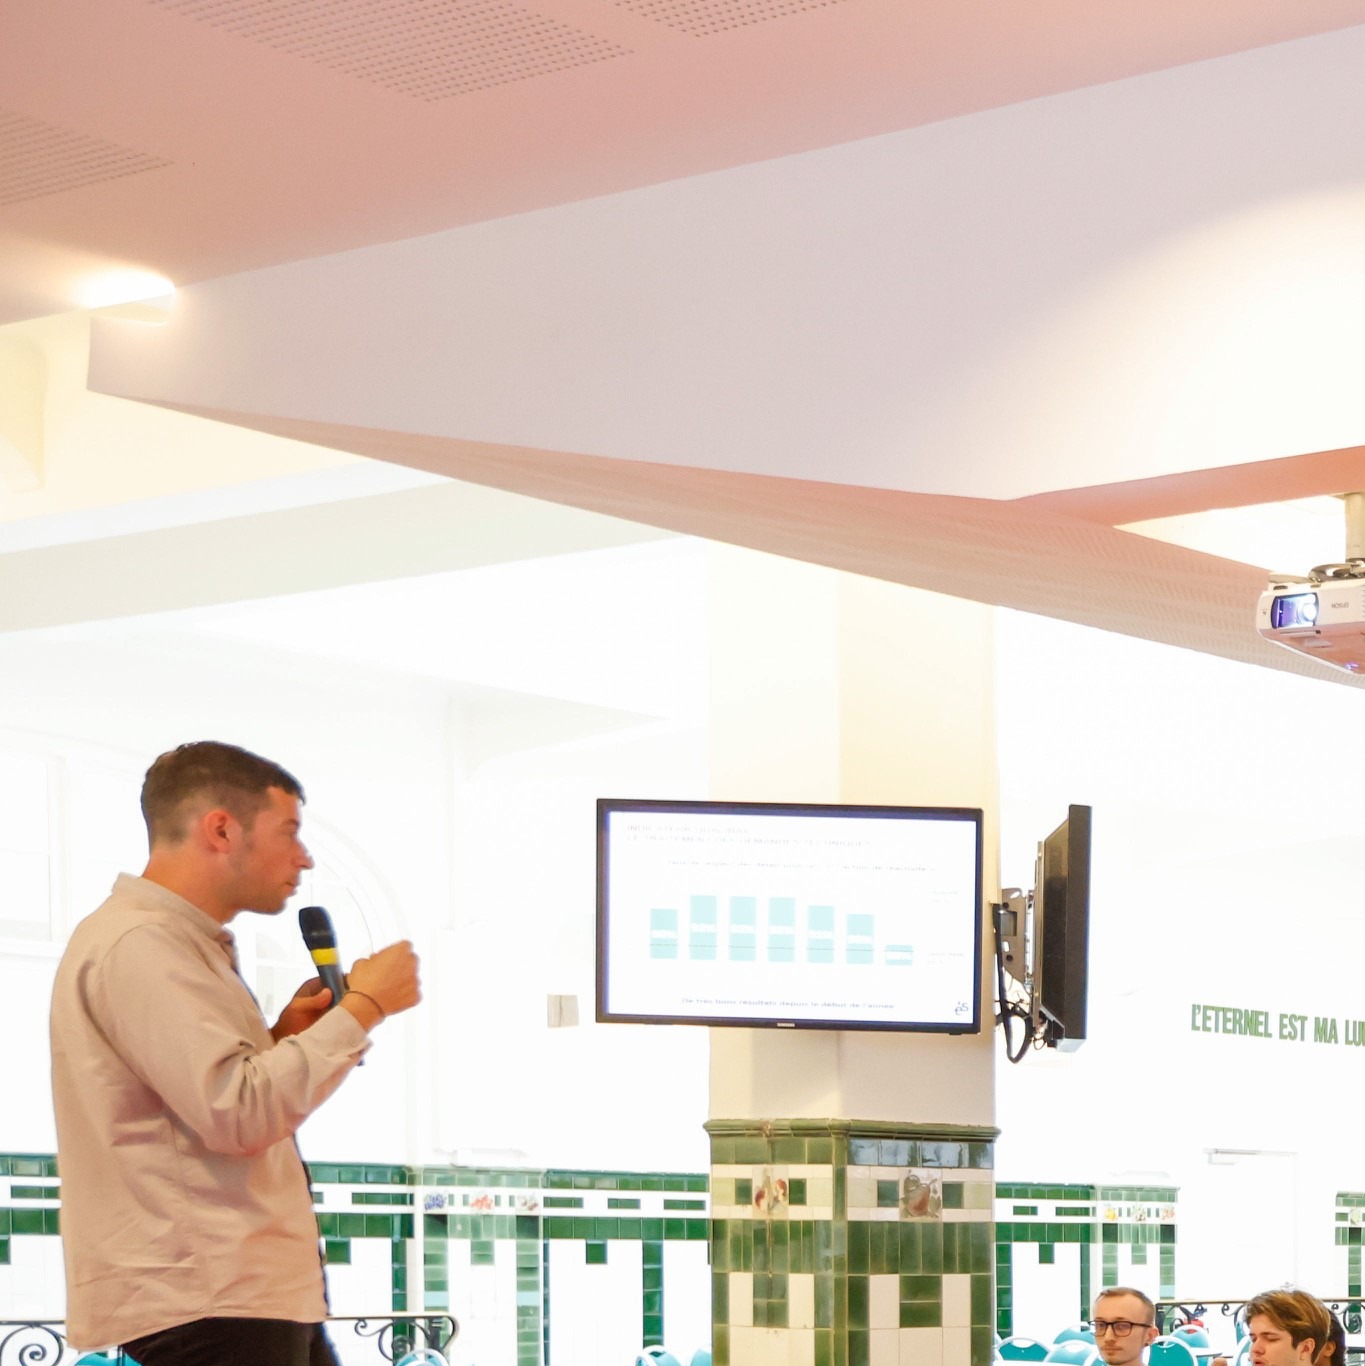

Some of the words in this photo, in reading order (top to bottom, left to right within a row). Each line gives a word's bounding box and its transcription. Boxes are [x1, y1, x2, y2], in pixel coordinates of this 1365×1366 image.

[1191, 1004, 1273, 1038] L'ETERNEL
[1279, 1013, 1308, 1042] EST
[1314, 1016, 1339, 1045] MA
